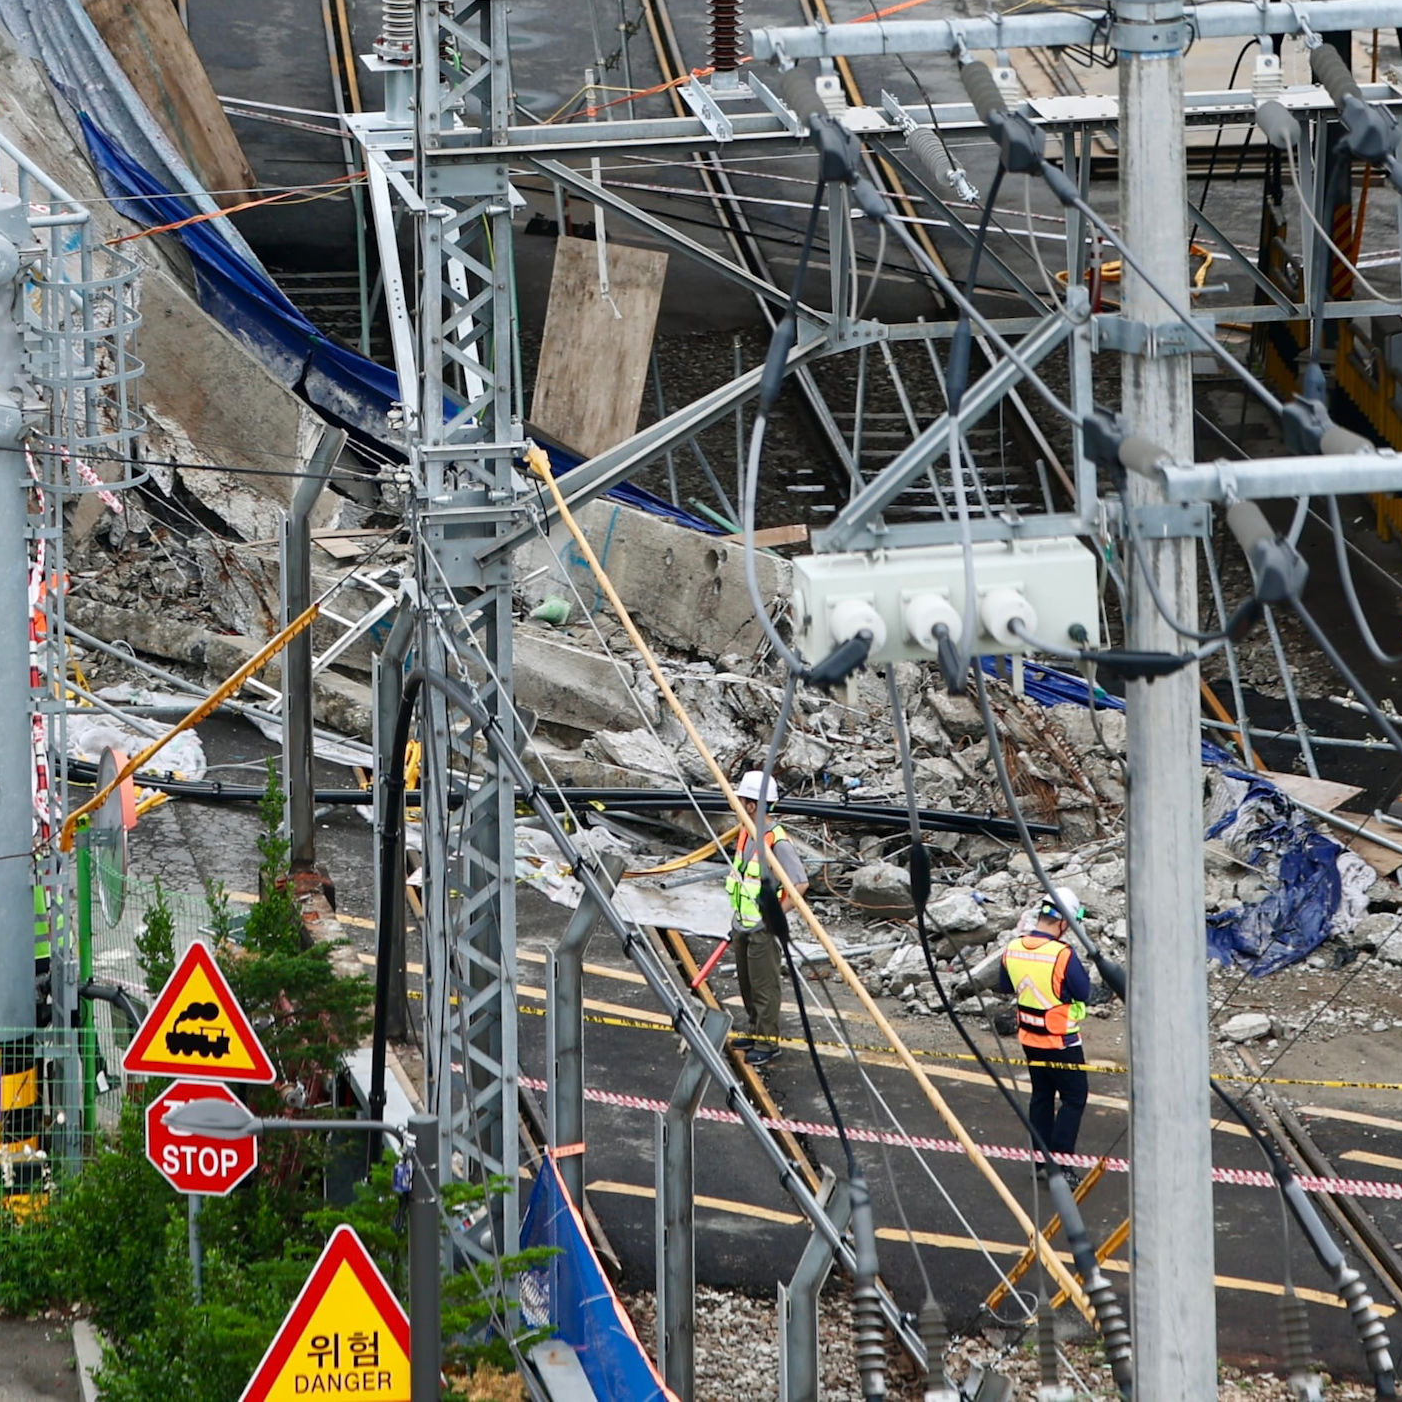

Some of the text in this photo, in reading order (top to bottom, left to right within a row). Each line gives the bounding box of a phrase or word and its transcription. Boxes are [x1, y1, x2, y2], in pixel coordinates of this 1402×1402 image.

[162, 1144, 238, 1177] STOP
[307, 1331, 379, 1368] 위험
[295, 1371, 391, 1394] DANGER
